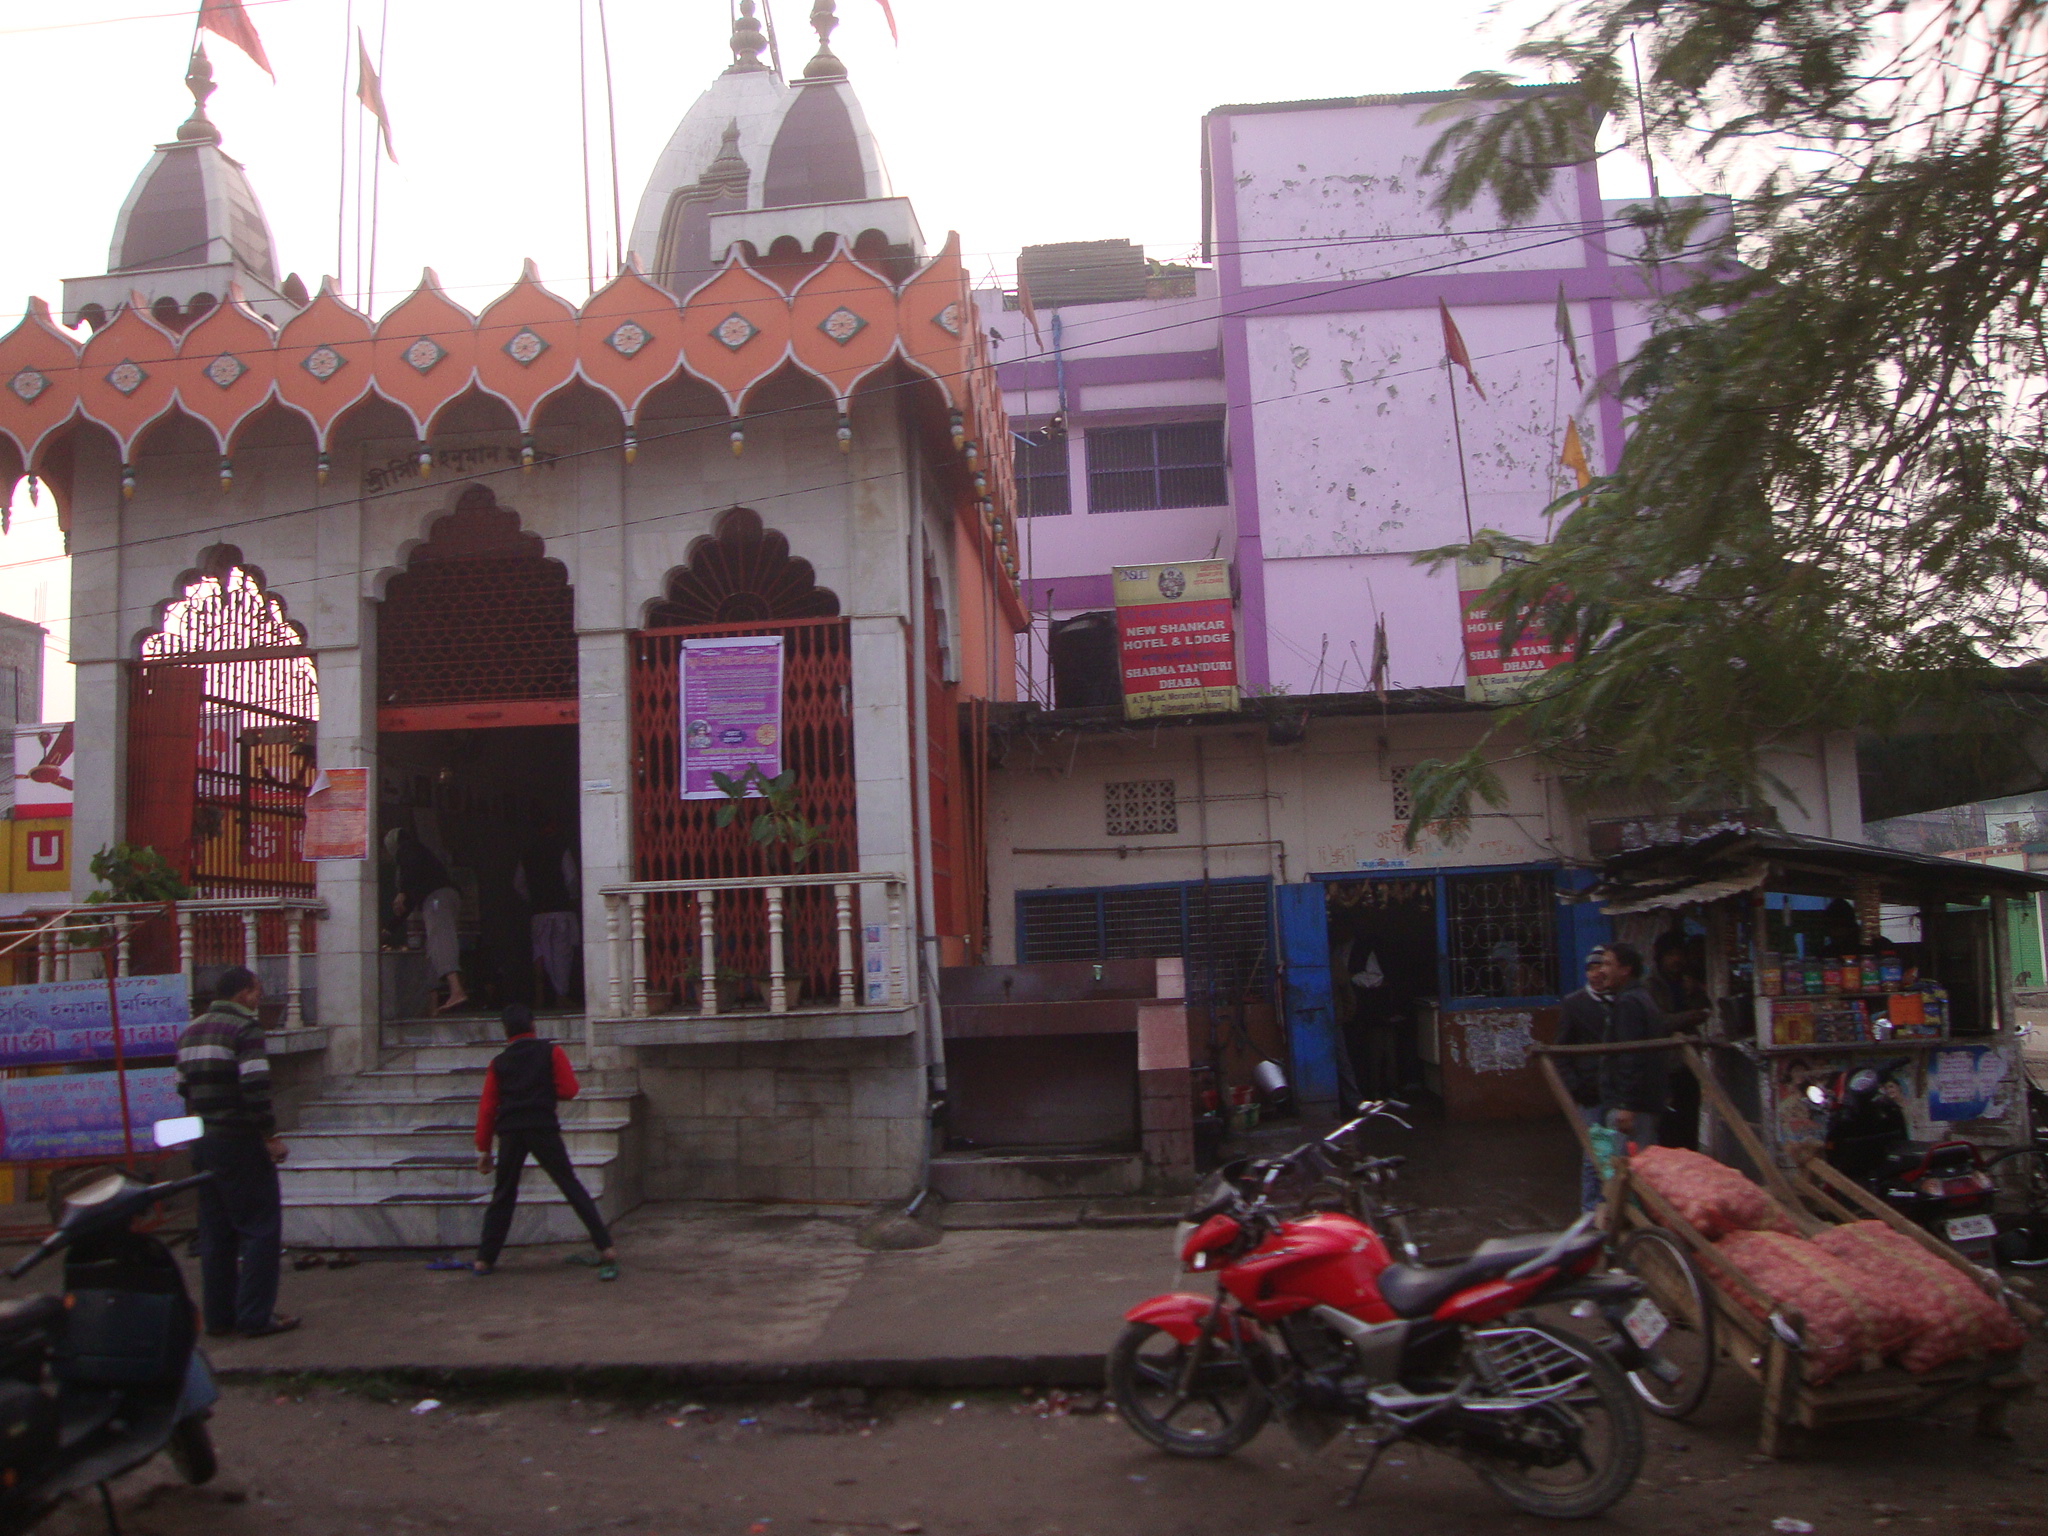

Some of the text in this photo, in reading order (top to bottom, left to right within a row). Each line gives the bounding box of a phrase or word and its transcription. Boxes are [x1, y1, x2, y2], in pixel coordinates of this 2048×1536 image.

[1126, 620, 1225, 637] NEW SHANKAR
[1467, 621, 1504, 633] HOTE
[1123, 633, 1230, 651] HOTEL & LODGE
[1469, 648, 1520, 661] SHARA
[1125, 660, 1233, 679] SHARMA TANDURI
[1159, 677, 1202, 690] DHABA
[32, 835, 59, 865] U
